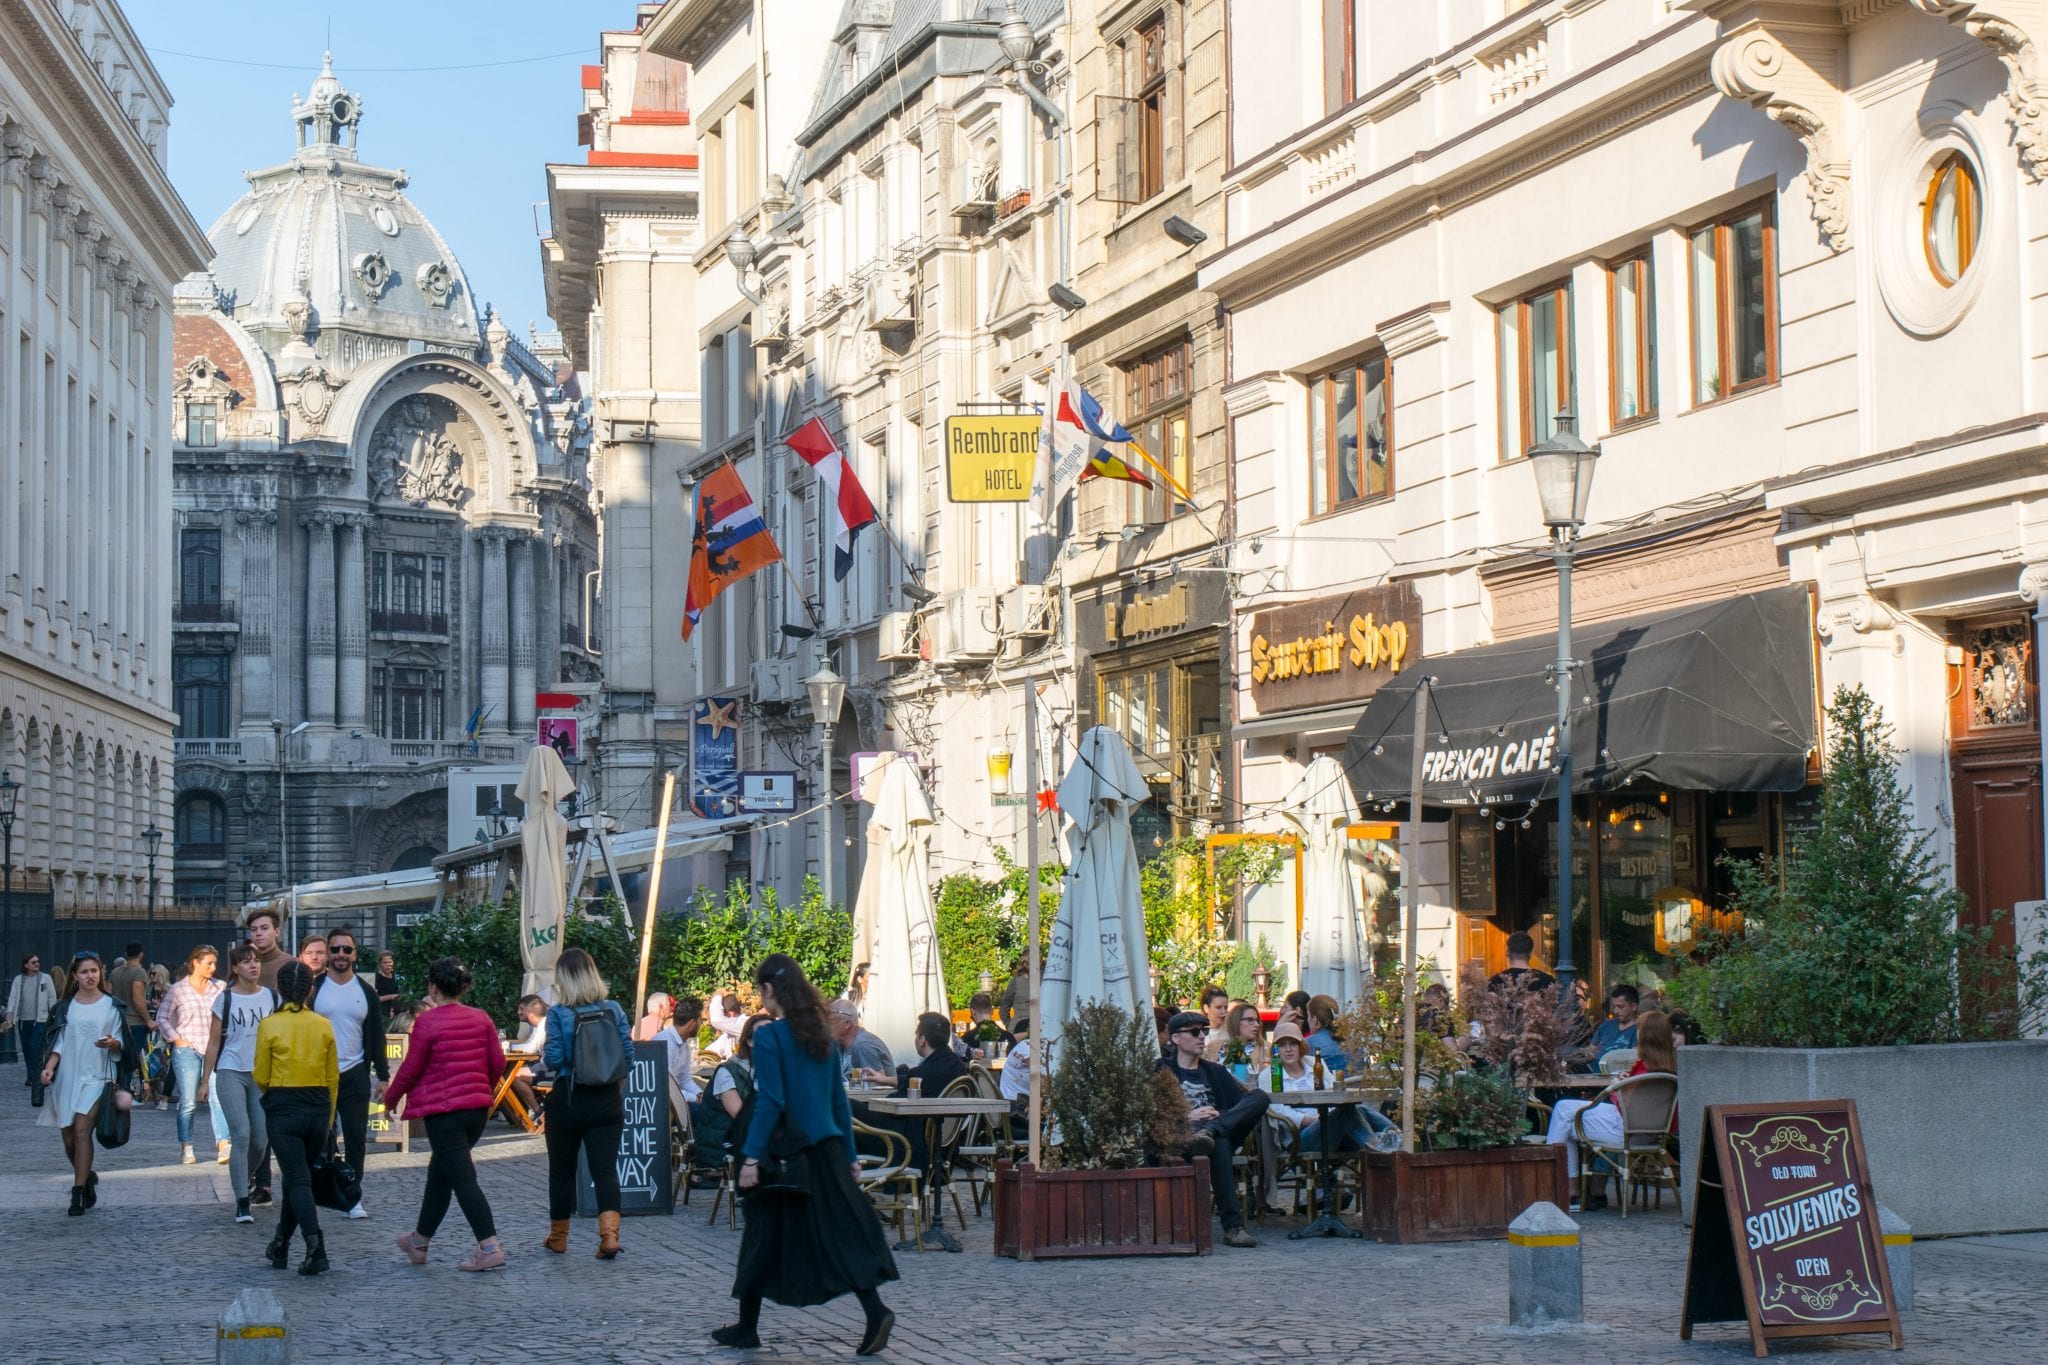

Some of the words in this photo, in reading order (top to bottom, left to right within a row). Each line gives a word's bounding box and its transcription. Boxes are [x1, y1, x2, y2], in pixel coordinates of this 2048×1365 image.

[953, 426, 1041, 454] Rembrand
[985, 469, 1022, 490] HOTEL
[1252, 620, 1346, 684] Souvenir
[1350, 612, 1407, 672] Shop
[1422, 745, 1499, 783] FRENCH
[1501, 725, 1556, 776] CAFÉ
[1620, 856, 1657, 877] BISTRO
[624, 1096, 657, 1125] STAY
[633, 1127, 657, 1155] ME
[1771, 1166, 1790, 1180] OLD
[1790, 1165, 1817, 1179] TOWN
[1745, 1183, 1861, 1251] SOUVENIRS
[1796, 1257, 1831, 1277] OPEN
